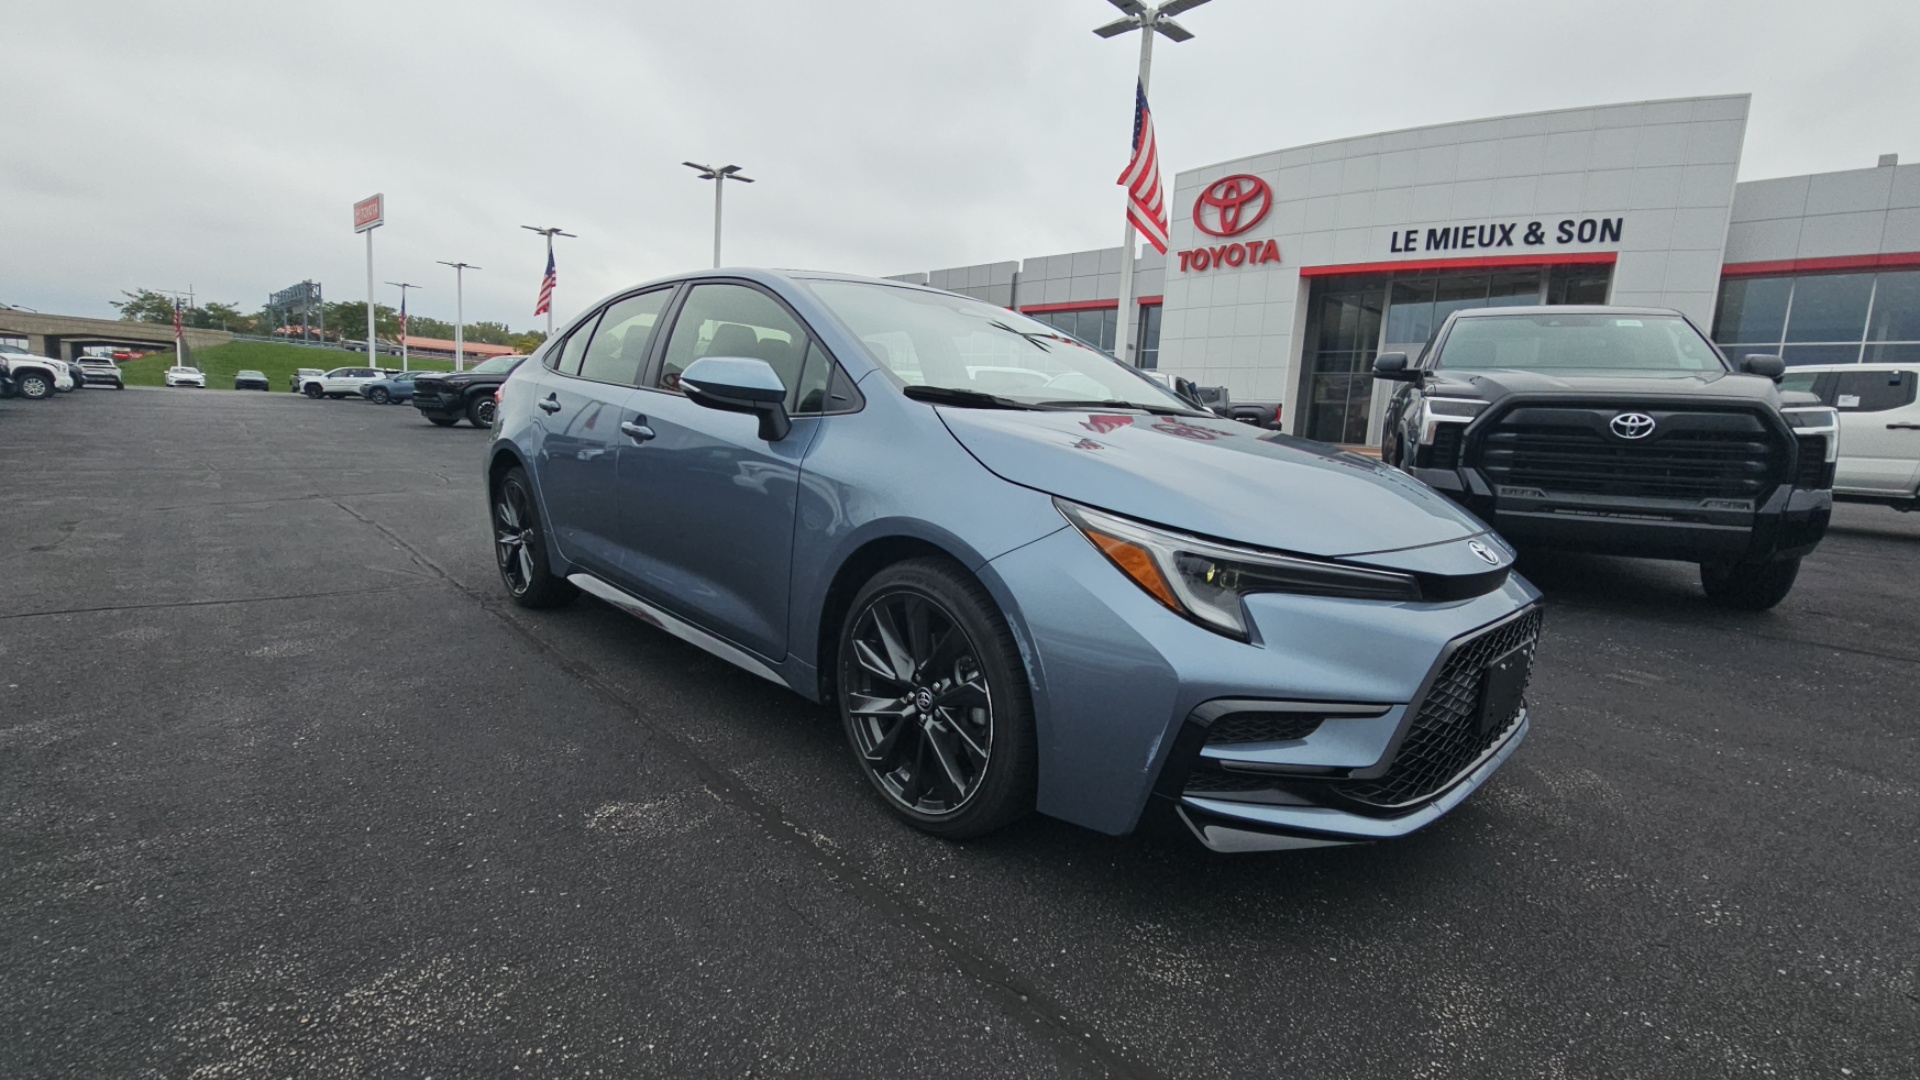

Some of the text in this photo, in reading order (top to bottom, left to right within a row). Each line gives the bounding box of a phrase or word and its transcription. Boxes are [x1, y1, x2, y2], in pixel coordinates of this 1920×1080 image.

[1390, 217, 1624, 253] LE MIEUX & SON
[1178, 240, 1281, 273] TOYOTA
